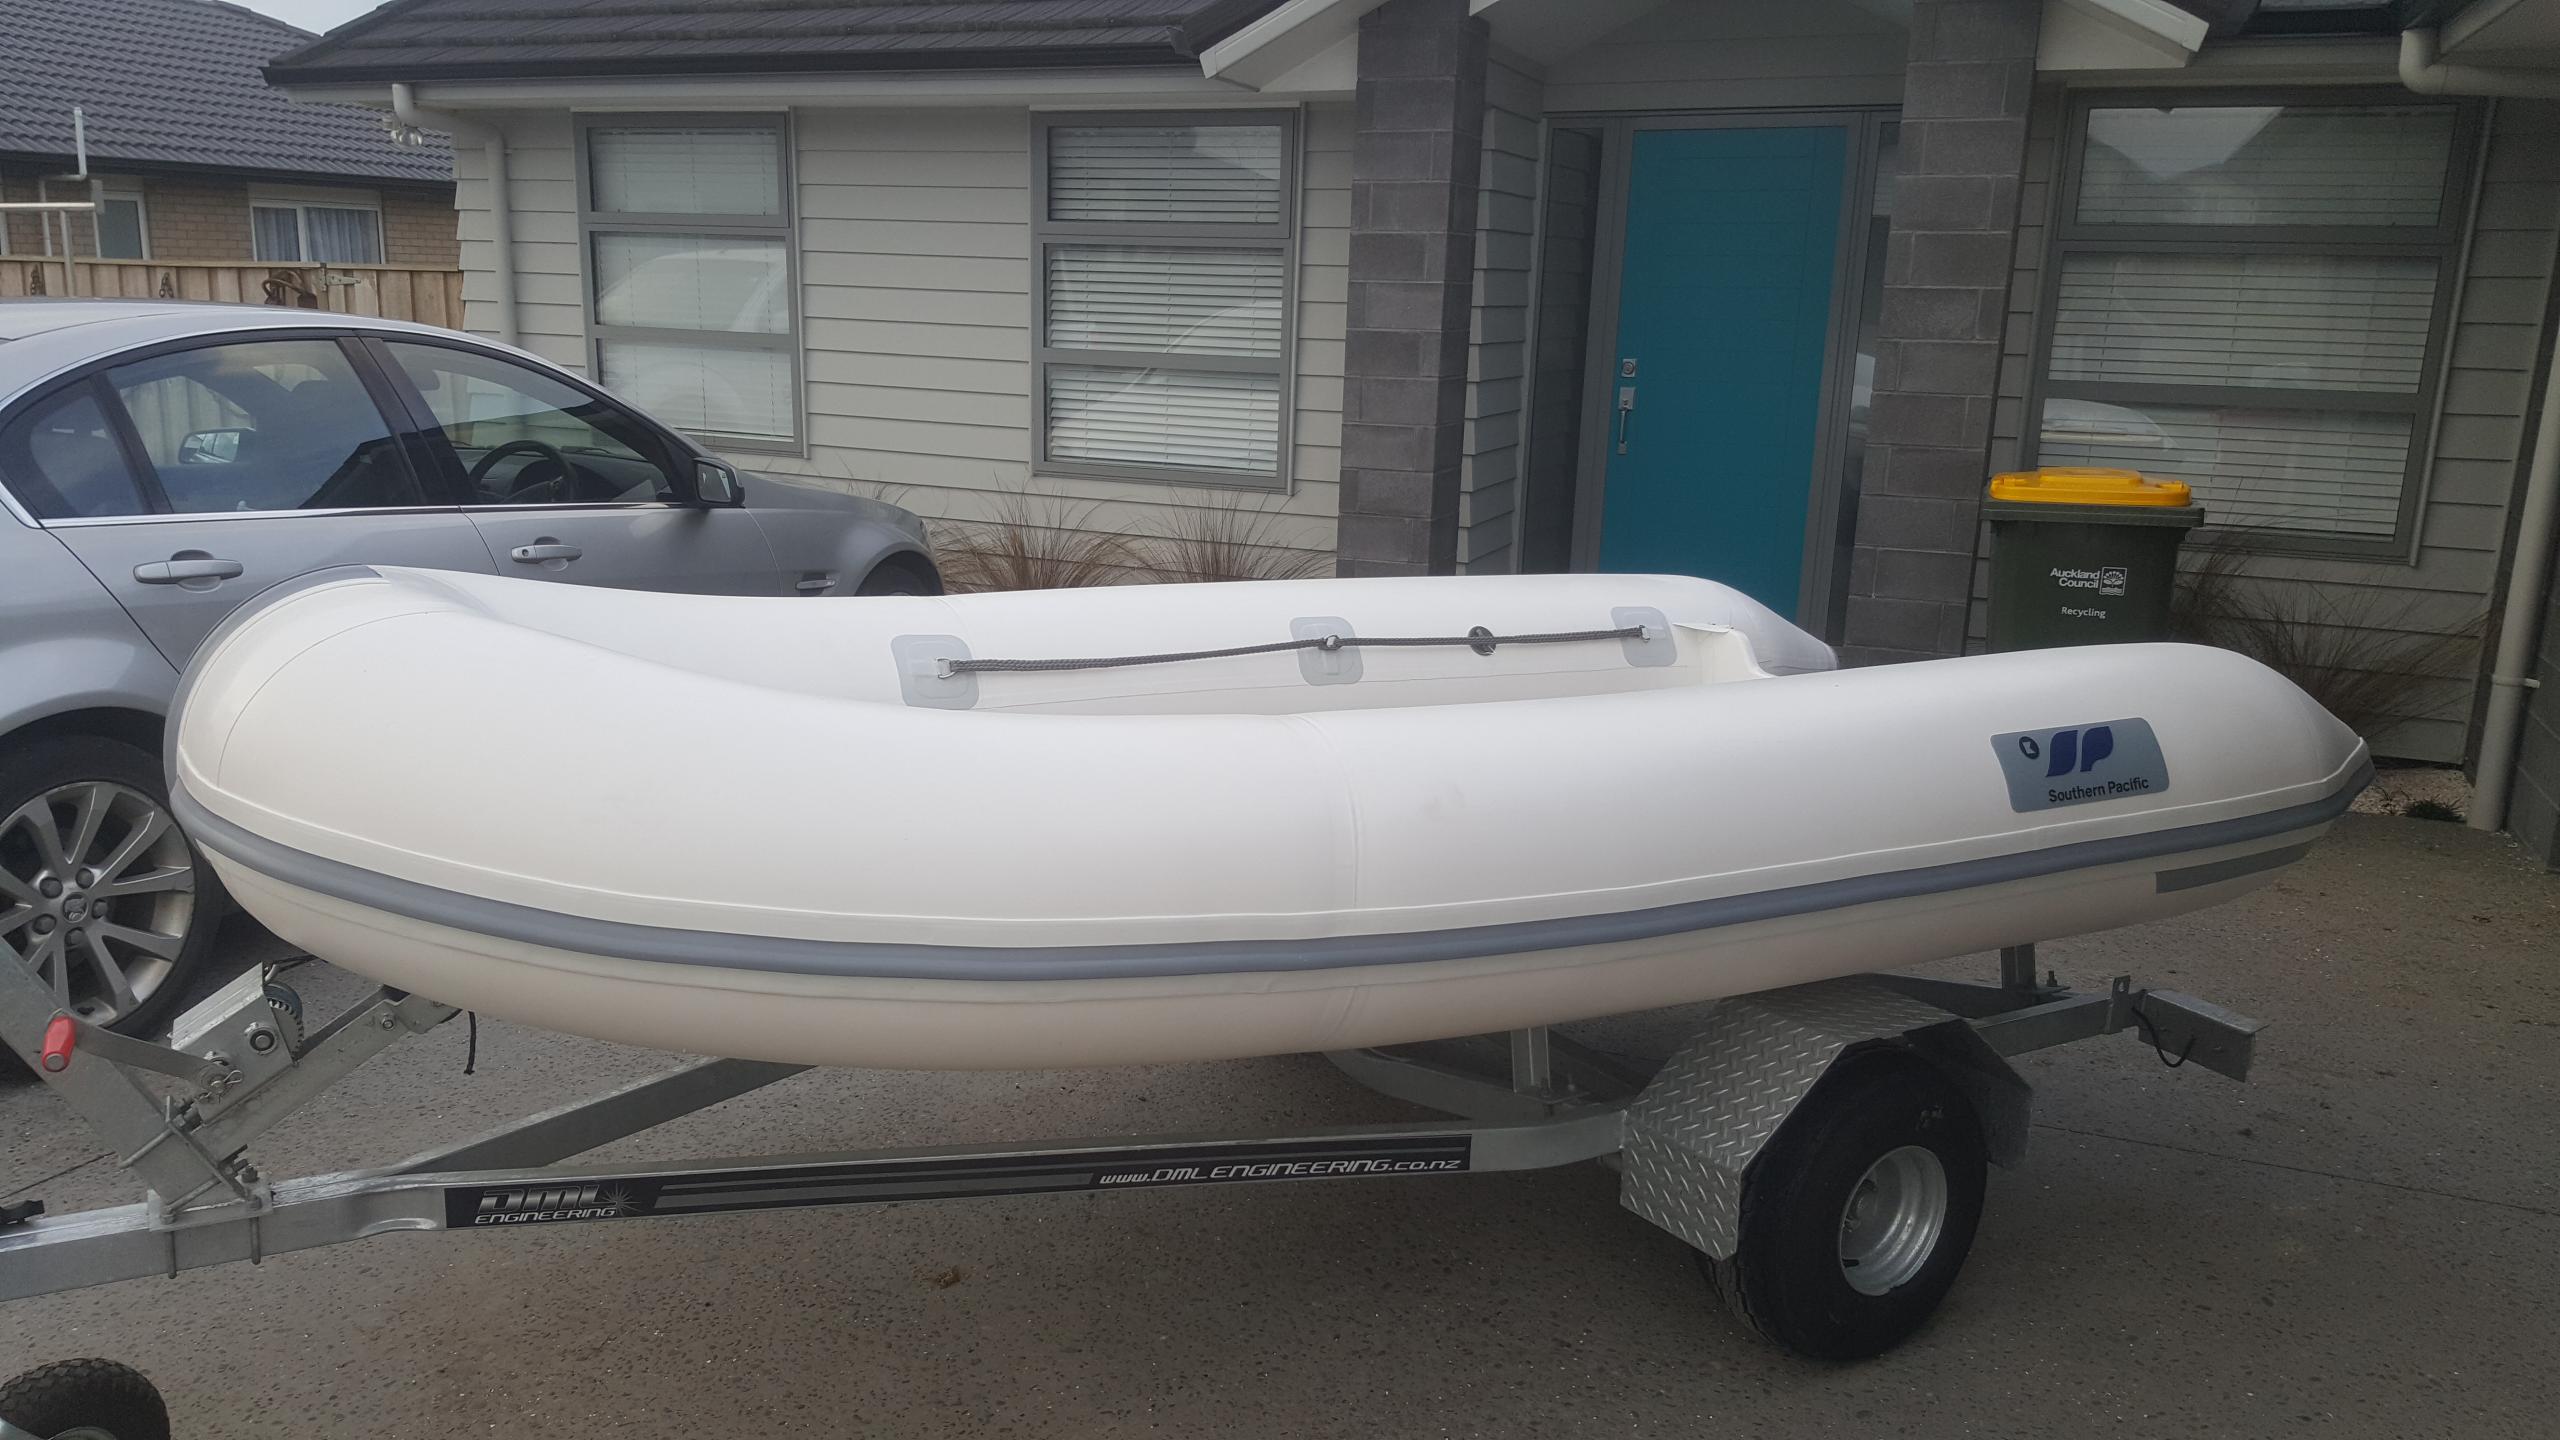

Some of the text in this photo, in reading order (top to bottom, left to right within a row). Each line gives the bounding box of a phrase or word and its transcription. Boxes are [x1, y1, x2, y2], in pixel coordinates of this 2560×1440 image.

[2050, 568, 2101, 579] Auckland
[2059, 577, 2099, 588] Council
[2061, 606, 2106, 619] Recycling
[2048, 777, 2149, 802] Southern Pacific
[475, 1206, 616, 1224] ENGINEERING
